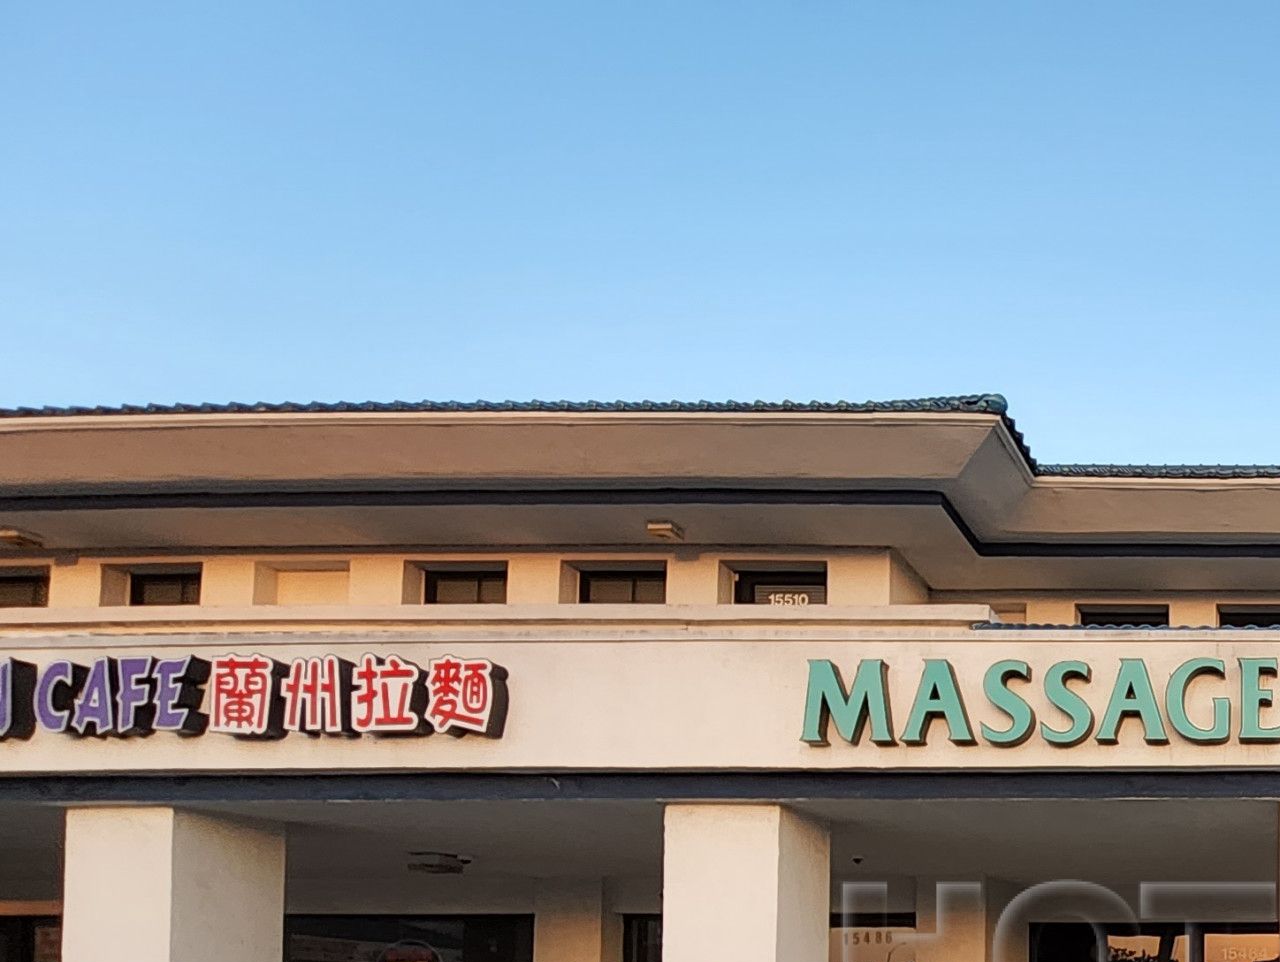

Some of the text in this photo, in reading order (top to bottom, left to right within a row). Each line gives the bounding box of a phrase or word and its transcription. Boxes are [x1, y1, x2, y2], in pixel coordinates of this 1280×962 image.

[768, 593, 809, 606] 15510
[34, 655, 192, 733] CAFE
[210, 653, 494, 734] 蘭州拉麵
[844, 931, 893, 945] 15486
